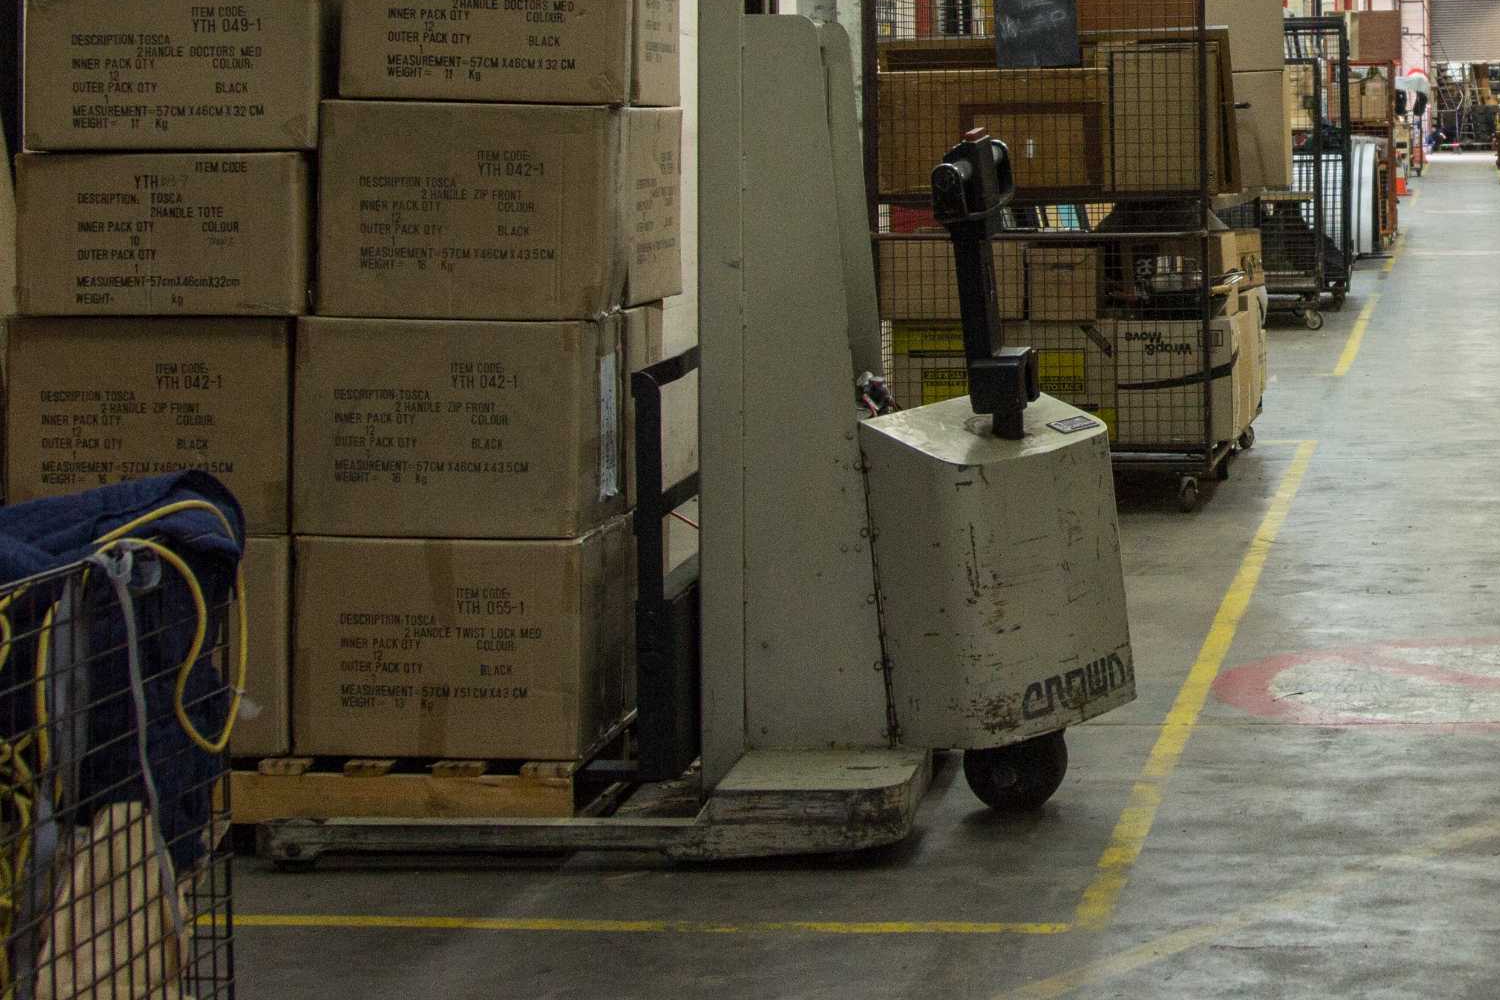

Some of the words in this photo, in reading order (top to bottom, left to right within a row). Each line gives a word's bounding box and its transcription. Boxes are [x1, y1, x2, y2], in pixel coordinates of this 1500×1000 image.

[504, 0, 548, 10] DOCTORS
[554, 1, 575, 11] MED
[191, 6, 215, 17] ITEM
[388, 8, 416, 19] INNER
[420, 9, 446, 19] PACK
[450, 10, 470, 20] QTY
[193, 19, 216, 32] YTH
[222, 18, 262, 32] 049-1
[388, 31, 419, 42] OUTER
[423, 32, 447, 43] PACK
[452, 33, 471, 44] QTY
[529, 35, 560, 47] BLACK
[189, 47, 235, 57] DOCTORS
[240, 47, 262, 57] MED
[72, 59, 100, 69] INNER
[105, 59, 131, 69] PACK
[135, 59, 155, 69] QTY
[73, 82, 104, 93] OUTER
[108, 82, 133, 93] PACK
[138, 82, 158, 92] QTY
[216, 82, 248, 93] BLACK
[195, 162, 218, 173] ITEM
[222, 161, 247, 173] CODE
[478, 163, 500, 176] YTH
[134, 175, 158, 189] YTH
[151, 193, 182, 204] TOSCA
[198, 206, 223, 218] TOTE
[78, 221, 104, 232] INNER
[108, 222, 132, 232] PACK
[136, 222, 154, 232] QTY
[202, 222, 239, 233] COLOUR
[360, 224, 390, 234] OUTER
[498, 225, 529, 236] BLACK
[77, 250, 108, 260] OUTER
[112, 250, 134, 260] PACK
[138, 250, 156, 260] QTY
[156, 376, 178, 389] YTH
[451, 375, 473, 388] YTH
[42, 438, 72, 449] OUTER
[177, 439, 208, 449] BLACK
[472, 438, 502, 449] BLACK
[457, 601, 480, 614] YTH
[456, 628, 485, 638] TWIST
[372, 638, 397, 648] PACK
